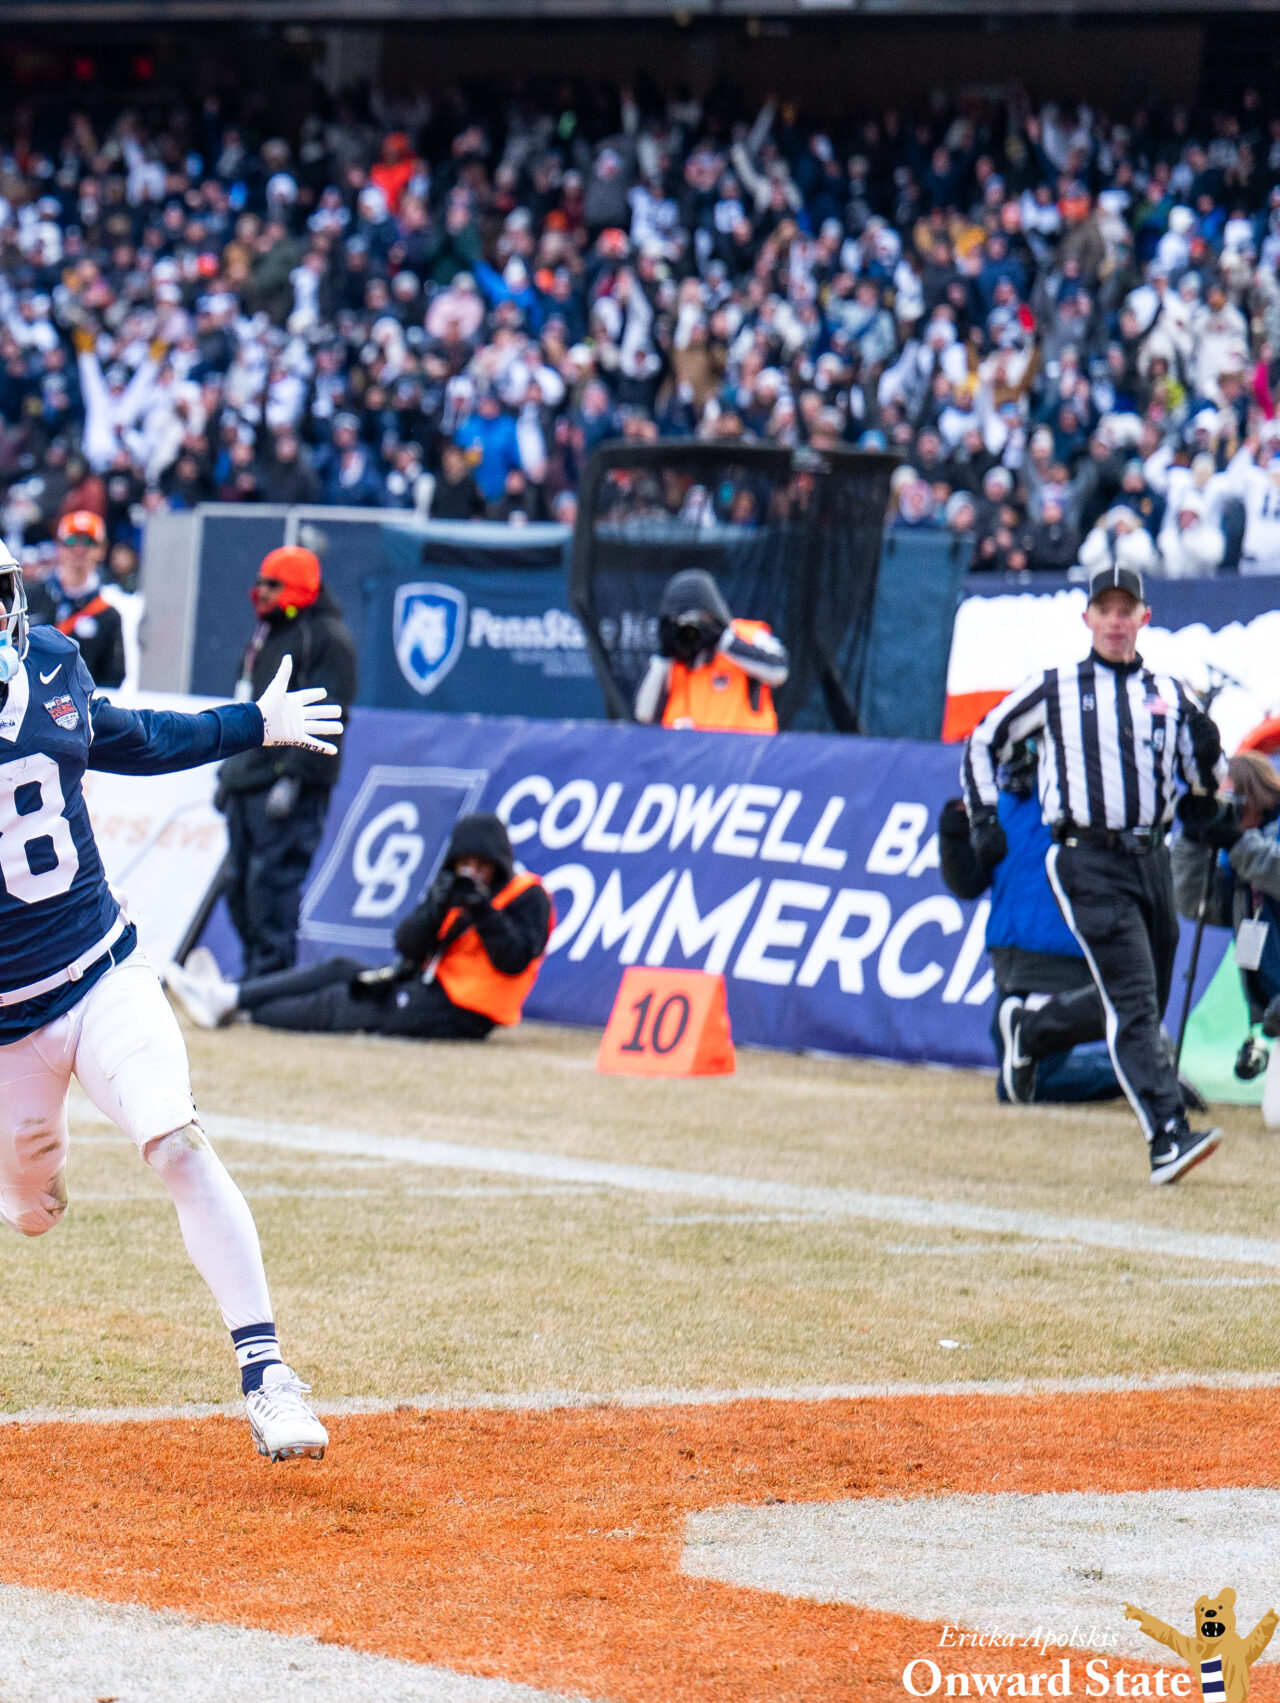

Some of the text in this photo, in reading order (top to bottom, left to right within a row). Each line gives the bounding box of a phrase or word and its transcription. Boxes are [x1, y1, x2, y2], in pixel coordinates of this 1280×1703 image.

[468, 607, 619, 650] PennStae
[496, 774, 848, 870] COLDWELL
[513, 860, 996, 1005] OMMERCI
[620, 992, 691, 1055] 10
